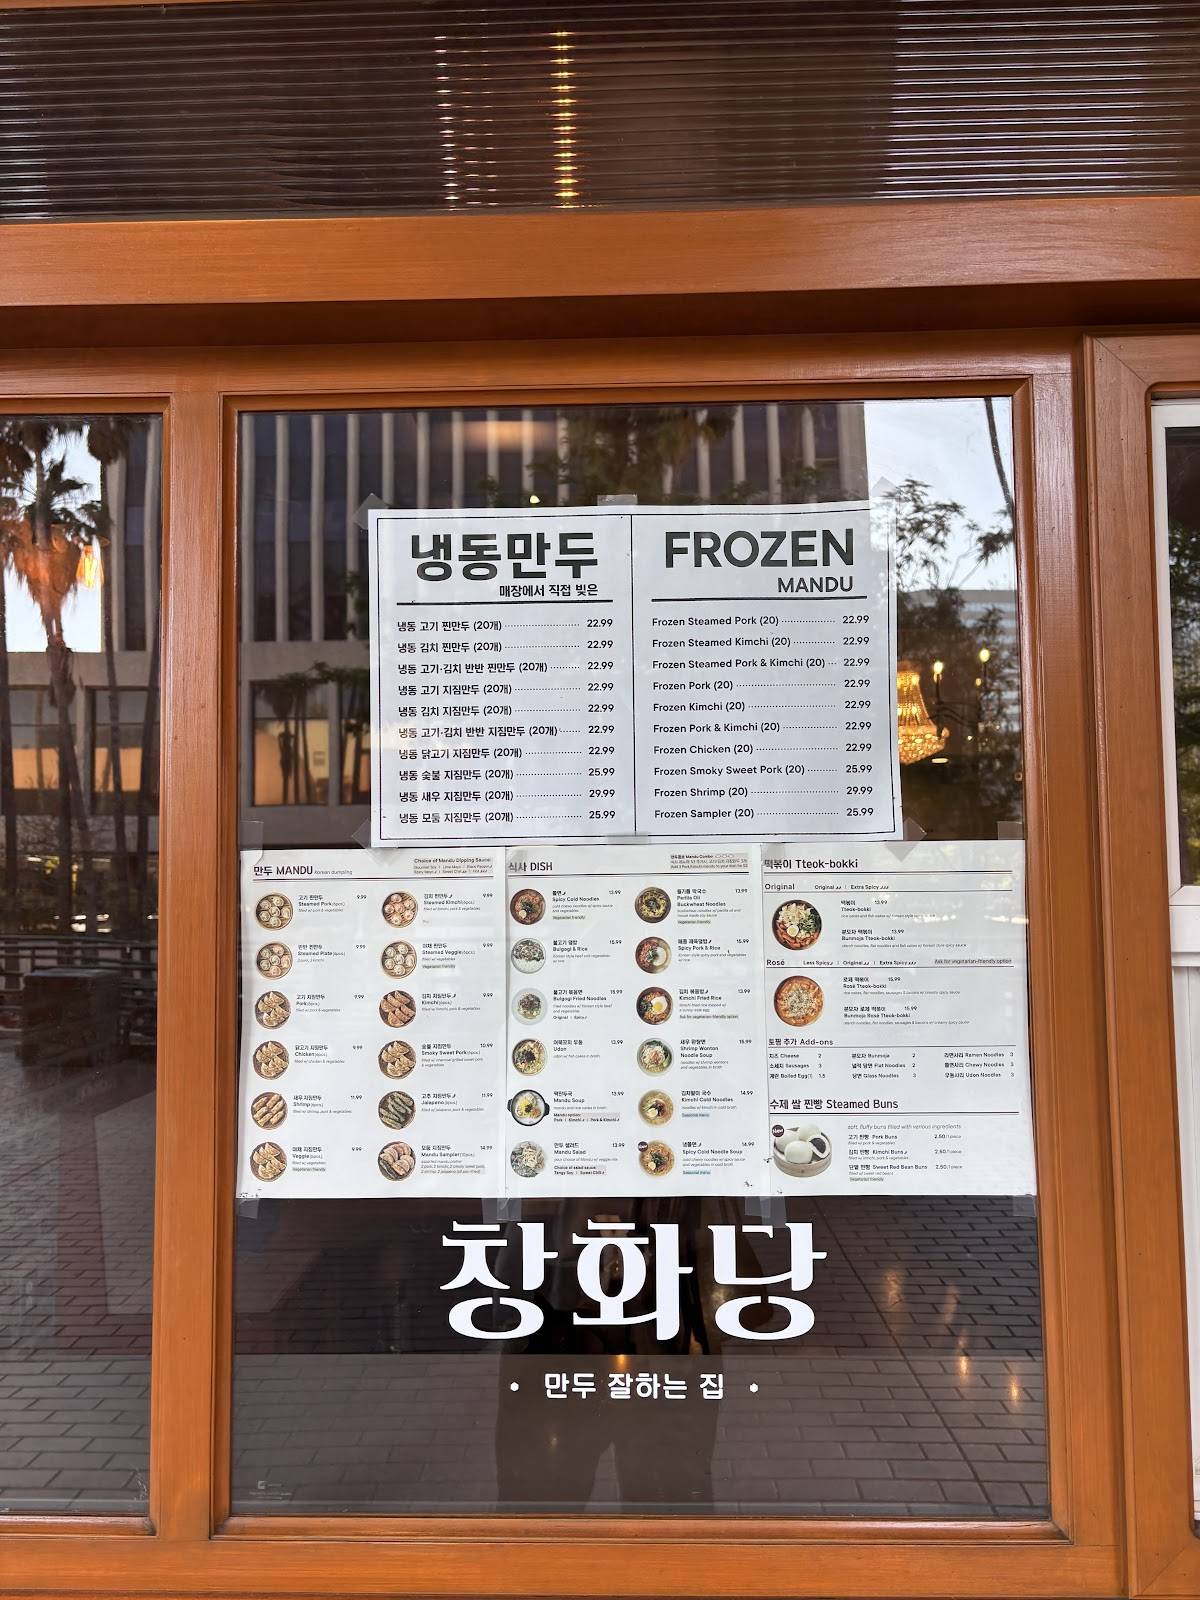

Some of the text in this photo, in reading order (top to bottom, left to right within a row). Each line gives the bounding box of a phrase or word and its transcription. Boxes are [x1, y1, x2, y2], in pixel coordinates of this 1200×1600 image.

[664, 527, 854, 568] FROZEN
[411, 532, 598, 582] 냉동만두
[499, 583, 598, 599] 매장에서 직접 빚은
[777, 575, 853, 593] MANDU
[396, 617, 613, 632] 냉동 고기 찐만두 (20개) 22.99
[652, 614, 869, 626] Frozen Steamed Pork (20) 22.99
[397, 639, 613, 654] 냉동 김치 찐만두 (20개) 22.99
[652, 635, 869, 648] Frozen Steamed Kimchi (20) 22.99
[397, 663, 417, 675] 냉동
[464, 663, 484, 674] 반반
[486, 662, 515, 673] 찐만두
[518, 662, 548, 674] (20개)
[587, 660, 615, 670] 22.99
[652, 656, 870, 669] Frozen Steamed Pork & Kimchi (20) 22.99
[397, 682, 616, 696] 냉동 고기 지짐만두 (20개) 22.99
[652, 678, 870, 691] Frozen Pork (20) 22.99
[398, 703, 614, 717] 냉동 김치 지짐만두 (20개) 22.99
[653, 698, 871, 712] Frozen Kimchi (20) 22.99
[398, 727, 418, 738] 냉동
[465, 726, 485, 737] 반반
[487, 726, 526, 737] 지짐만두
[528, 723, 558, 737] (20개)
[588, 724, 614, 734] 22.99
[653, 720, 871, 733] Frozen Pork & Kimchi (20) 22.99
[398, 746, 615, 760] 냉동 닭고기 지짐만두 (20개) 22.99
[653, 742, 872, 755] Frozen Chicken (20) 22.99
[398, 770, 418, 781] 냉동
[443, 769, 482, 780] 지짐만두
[484, 769, 513, 780] (20개)
[588, 767, 615, 776] 25.99
[654, 764, 872, 776] Frozen Smoky Sweet Pork (20) 25.99
[398, 788, 615, 802] 냉동 새우 지짐만두 (20개) 29.99
[654, 785, 873, 799] Frozen Shrimp (20) 29.99
[399, 812, 418, 824] 냉동
[443, 812, 481, 823] 지짐만두
[484, 811, 514, 824] (20개)
[588, 810, 616, 820] 25.99
[654, 807, 874, 820] Frozen Sampler (20) 25.99
[253, 865, 313, 876] 만두 MANDU
[530, 861, 552, 871] DISH
[794, 858, 858, 869] Tteok-bokki
[768, 1038, 834, 1046] 토핑 추가 Add-ons
[768, 1098, 900, 1110] 수제 쌀 찐빵 Steamed Buns
[439, 1218, 828, 1341] 창화당
[544, 1372, 724, 1399] 만두 잘하는 집
